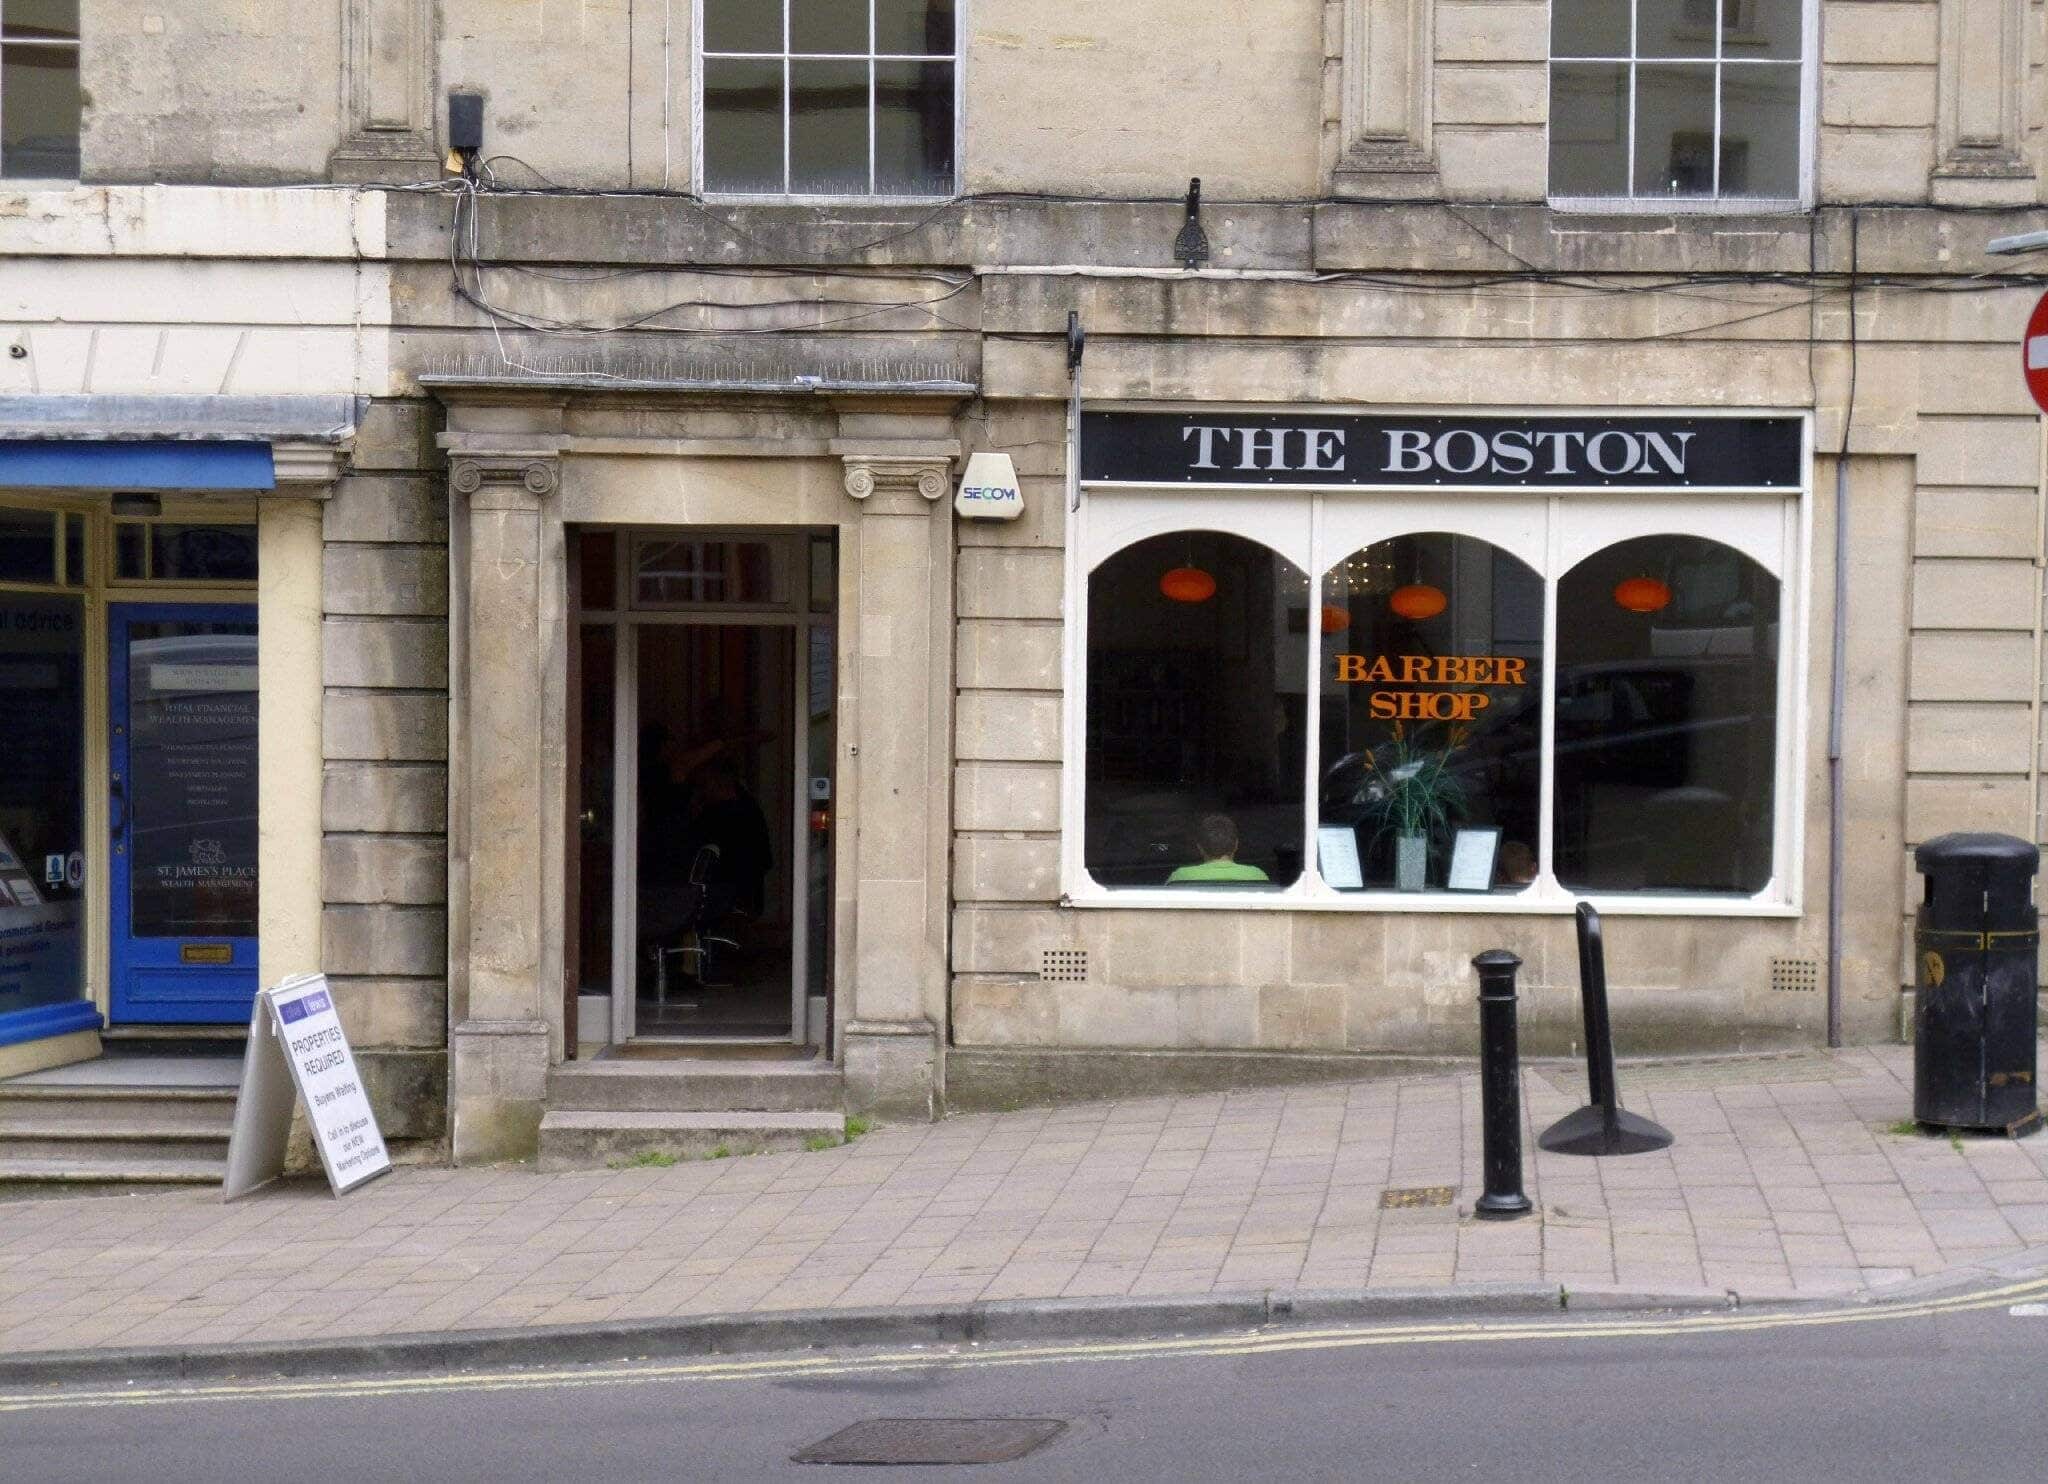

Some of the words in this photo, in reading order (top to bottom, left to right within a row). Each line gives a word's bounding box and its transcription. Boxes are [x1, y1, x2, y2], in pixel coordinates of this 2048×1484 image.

[1183, 426, 1345, 472] THE
[1380, 430, 1697, 475] BOSTON
[963, 487, 1016, 501] SECOM
[1334, 654, 1528, 685] BARBER
[1370, 691, 1490, 721] SHOP
[158, 866, 173, 876] ST.
[176, 866, 218, 878] JAMES'S
[222, 866, 257, 877] PLACE
[161, 879, 194, 888] WEALTH
[291, 1026, 342, 1057] PROPERTIES
[304, 1049, 345, 1075] REQUIRED
[314, 1088, 335, 1108] Buyers
[335, 1080, 357, 1101] Waiting
